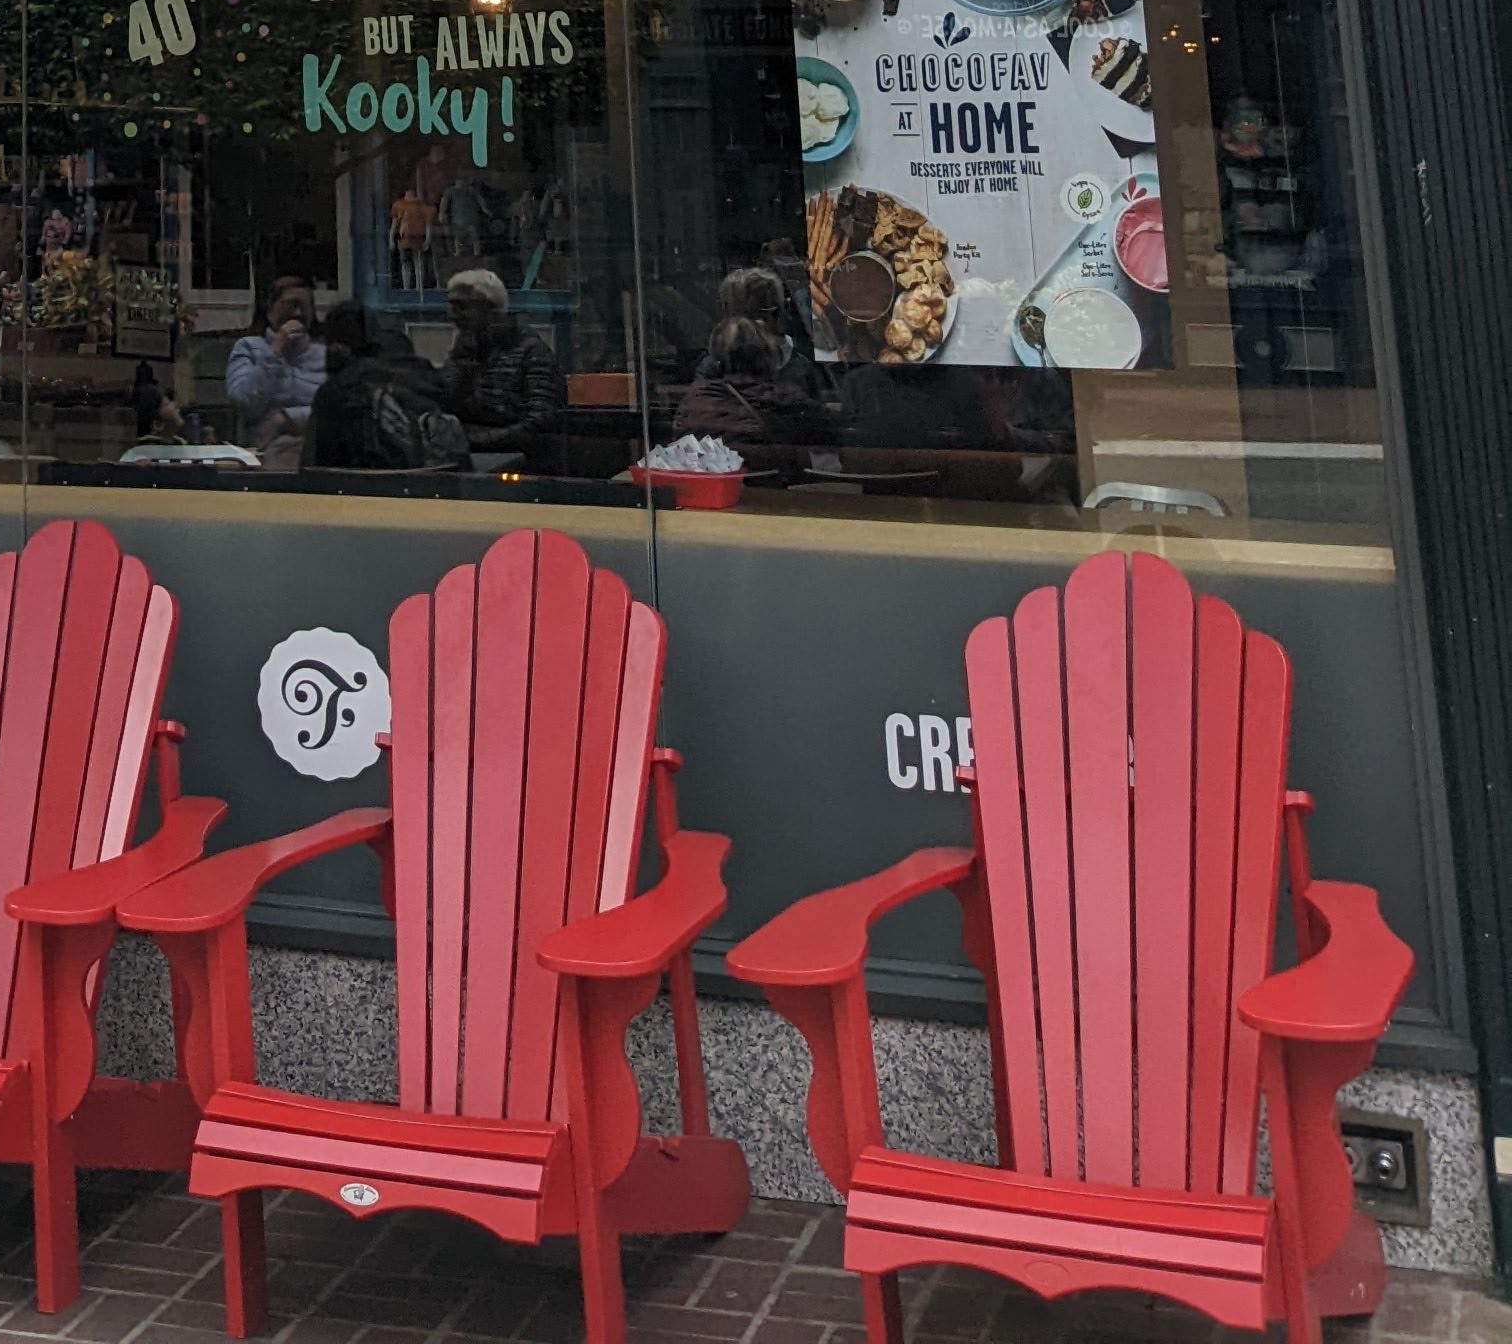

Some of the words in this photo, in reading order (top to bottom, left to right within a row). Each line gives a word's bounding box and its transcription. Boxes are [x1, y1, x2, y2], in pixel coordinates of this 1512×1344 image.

[362, 13, 416, 56] BUT
[435, 10, 574, 71] ALWAYS
[875, 52, 1050, 92] CHOCOFAV
[301, 52, 516, 168] Kooky!
[898, 111, 913, 130] AT
[929, 101, 1041, 154] HOME
[910, 161, 962, 178] DESSERTS
[964, 159, 1017, 177] EVERYONE
[1020, 159, 1045, 176] WILL
[937, 178, 970, 194] ENJOY
[974, 178, 985, 193] AT
[989, 177, 1019, 192] HOME
